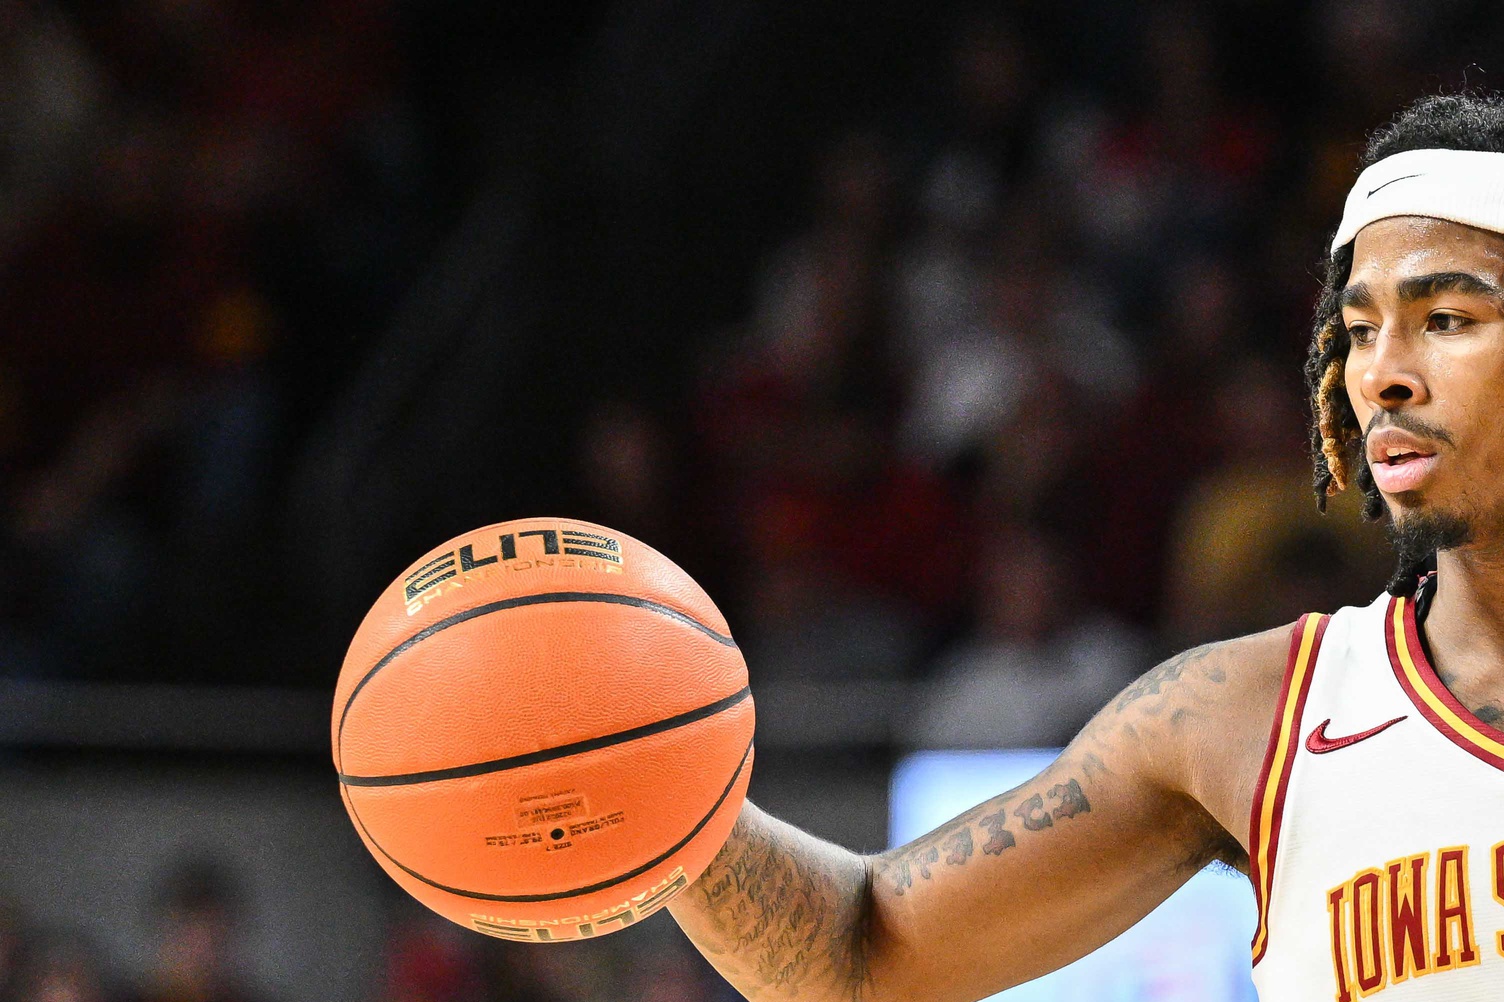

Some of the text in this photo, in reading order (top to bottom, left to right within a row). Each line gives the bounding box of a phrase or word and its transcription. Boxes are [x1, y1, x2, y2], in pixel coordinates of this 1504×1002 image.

[404, 529, 622, 604] ELITE
[406, 557, 623, 616] CHAMPIONSHIP
[469, 866, 684, 927] CHAMPIONSHIP
